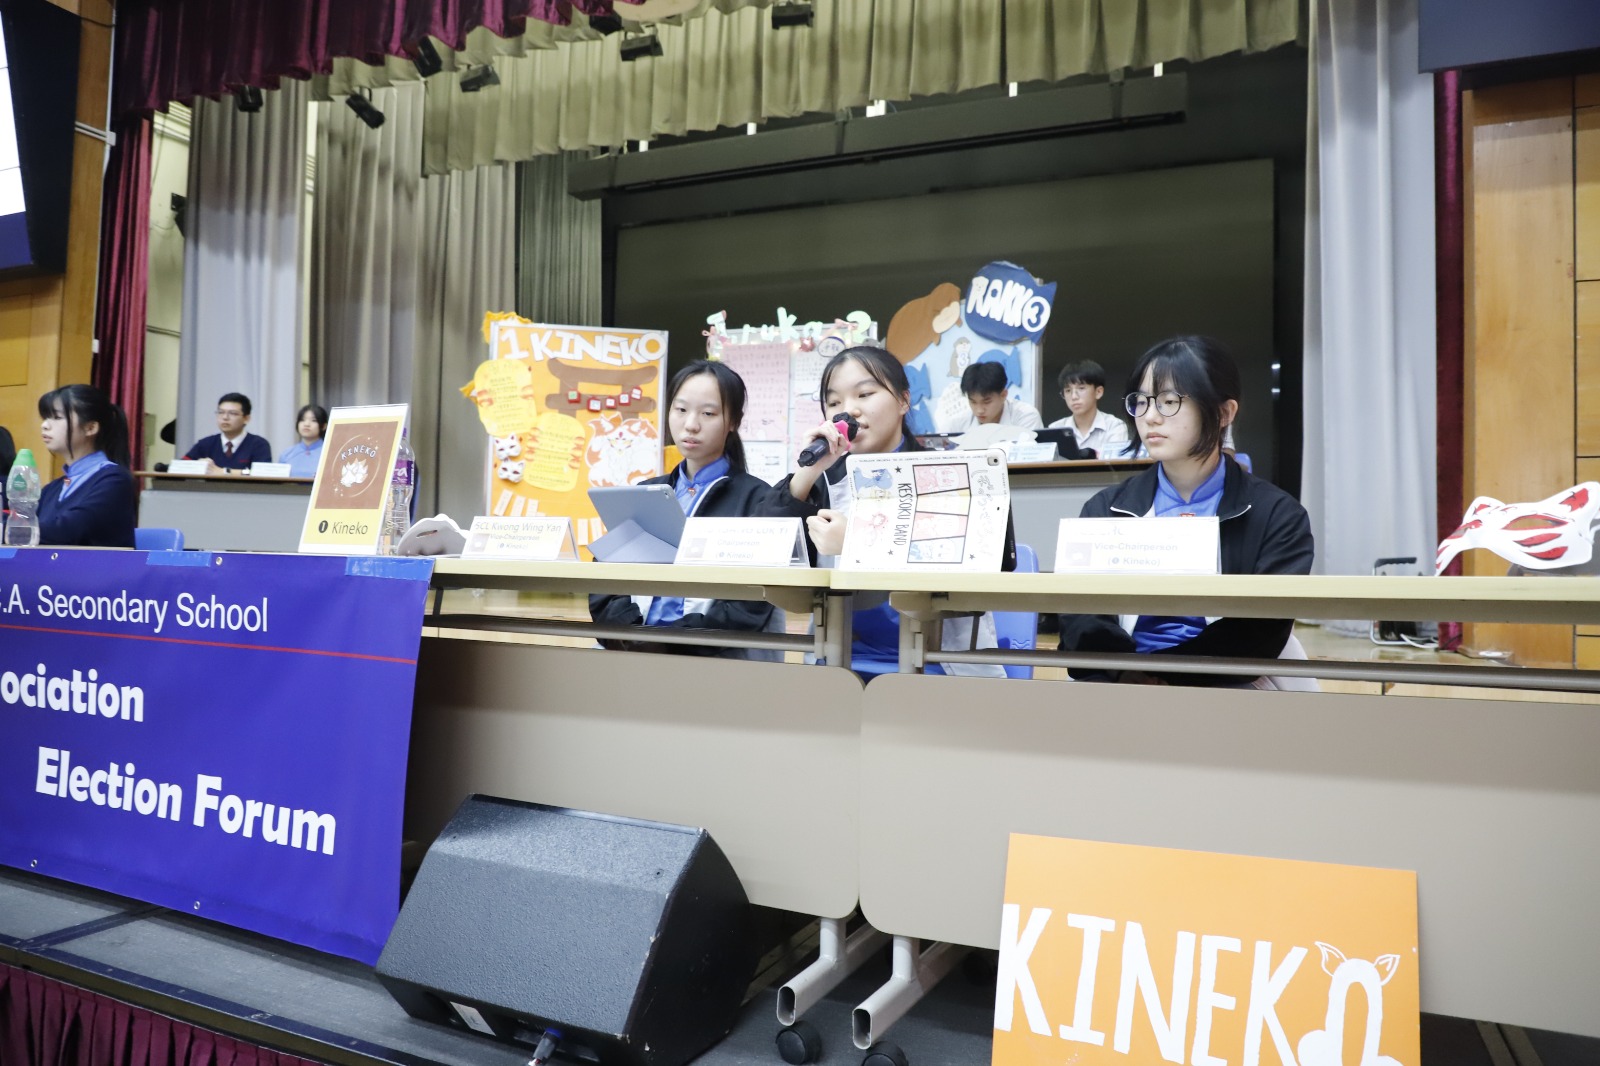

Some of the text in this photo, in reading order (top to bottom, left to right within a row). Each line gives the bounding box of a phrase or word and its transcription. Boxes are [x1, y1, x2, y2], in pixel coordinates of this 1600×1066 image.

[501, 328, 667, 367] 1 KINEKO
[341, 445, 376, 461] KINEKO
[893, 482, 913, 546] KESSOKU BAND
[331, 521, 369, 535] Kineko
[492, 522, 519, 533] Kwong
[522, 523, 544, 533] Wing
[546, 523, 562, 532] Yan
[490, 533, 540, 542] Vice-Chairperson
[717, 538, 761, 547] Chairperson
[1094, 542, 1178, 552] Vice-Chairperson
[1122, 557, 1161, 567] Kineko)
[37, 585, 168, 633] Secondary
[176, 592, 269, 632] School
[36, 746, 337, 856] Election Forum
